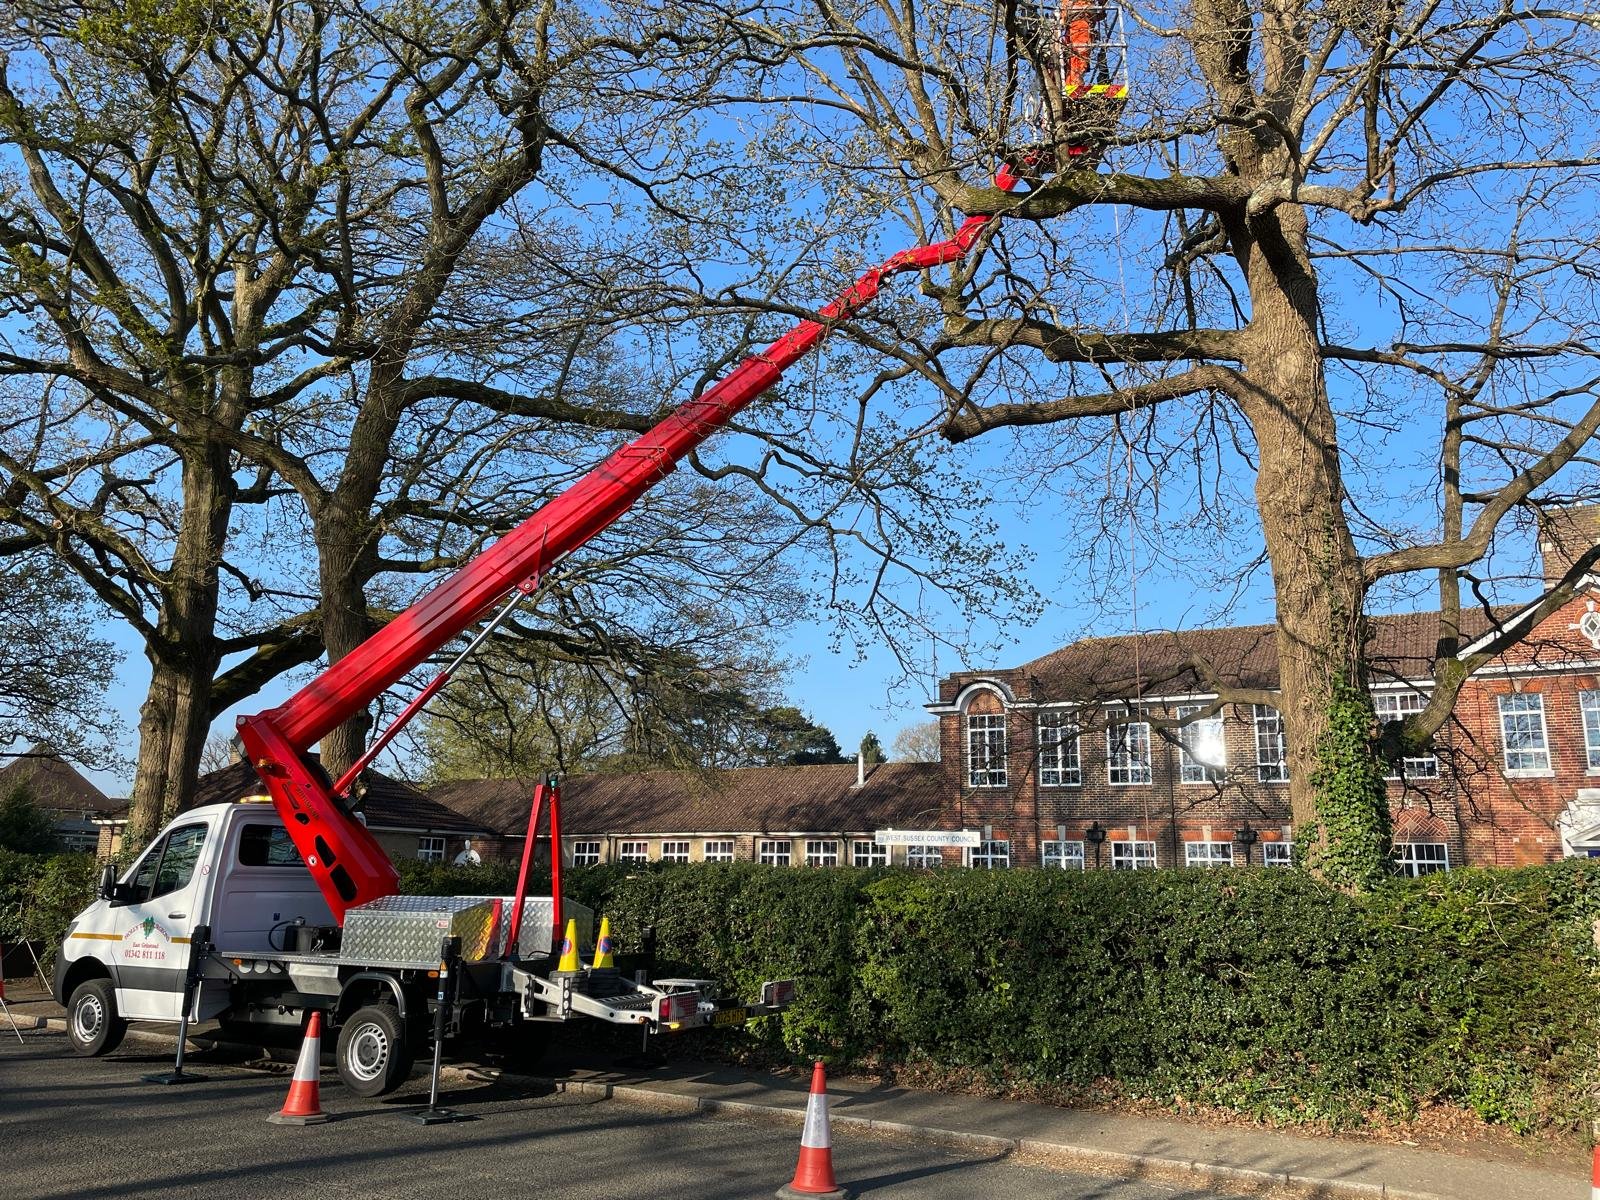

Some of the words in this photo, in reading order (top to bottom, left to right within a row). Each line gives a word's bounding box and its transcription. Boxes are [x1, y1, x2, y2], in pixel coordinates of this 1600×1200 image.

[903, 834, 924, 842] SUSSEX
[124, 949, 140, 958] 01342
[142, 950, 153, 959] 811
[155, 951, 166, 960] 118
